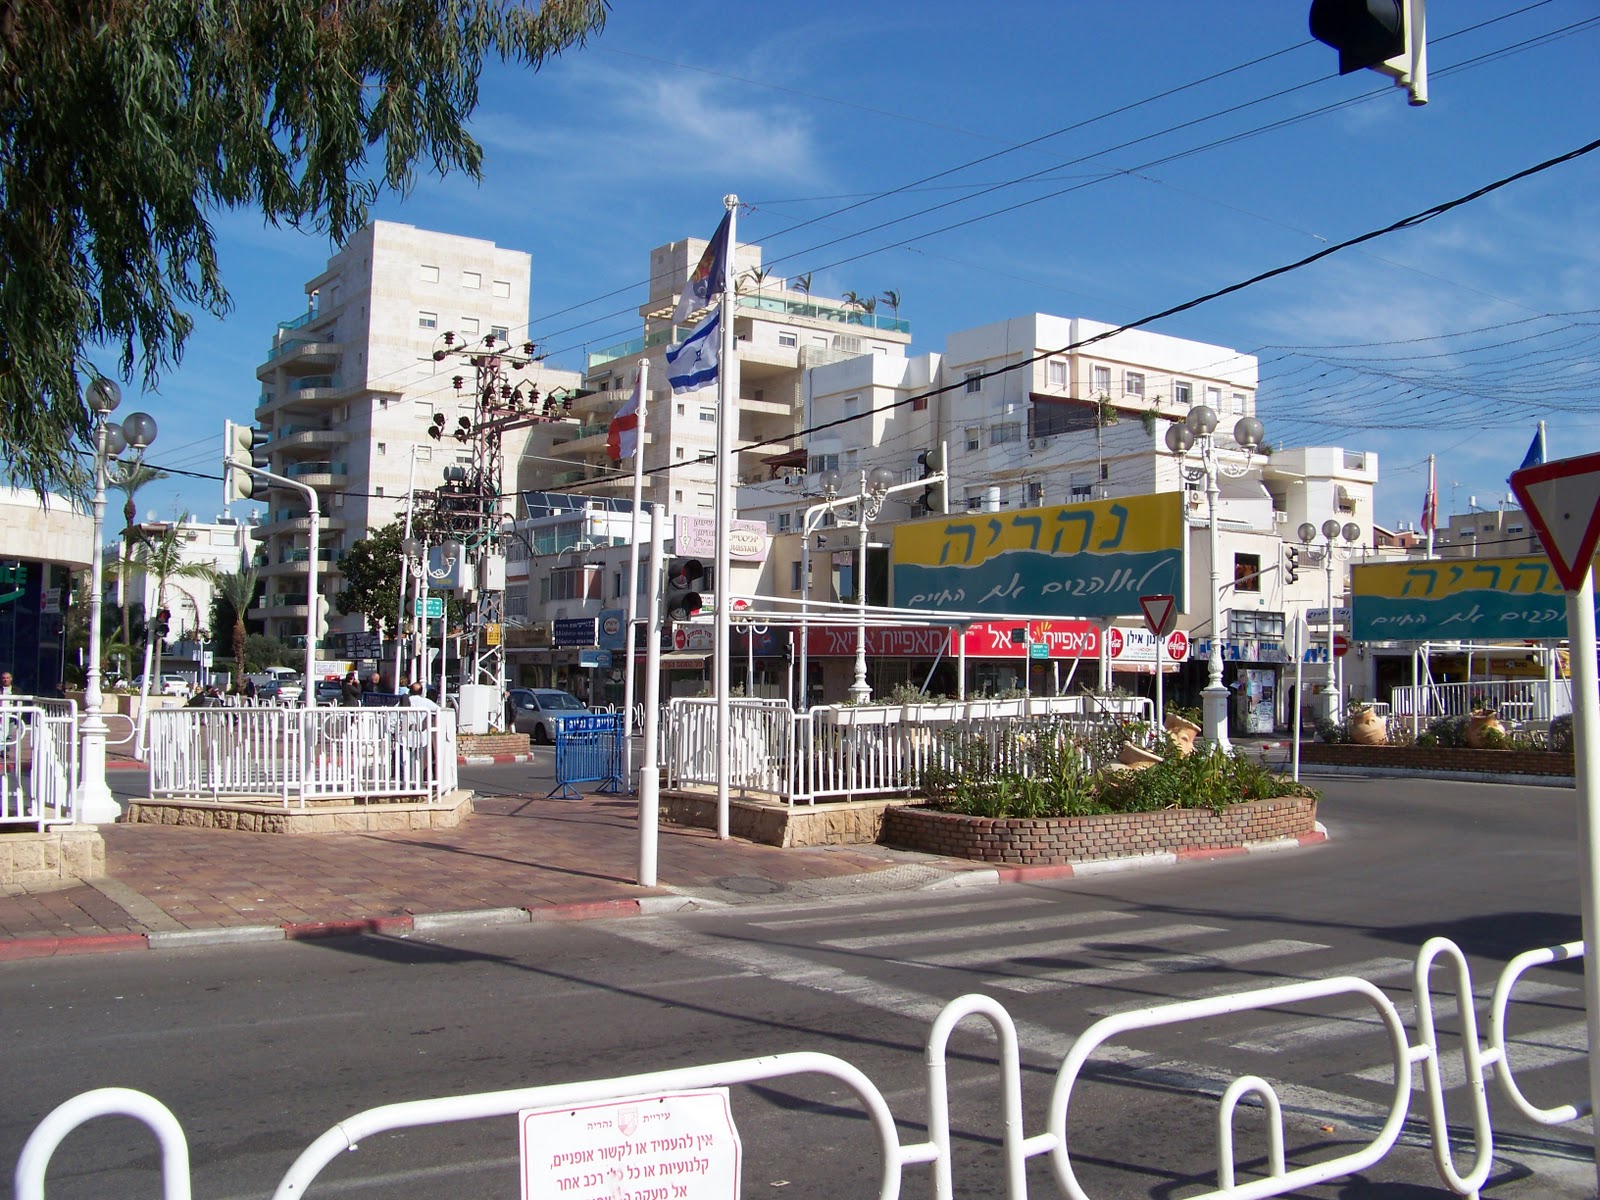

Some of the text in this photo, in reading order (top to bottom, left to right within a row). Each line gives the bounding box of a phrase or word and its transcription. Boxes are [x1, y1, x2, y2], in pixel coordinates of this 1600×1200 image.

[939, 503, 1129, 565] נהריה
[908, 557, 1175, 607] לאוהבים את החיים
[1401, 562, 1563, 597] הריה
[1371, 604, 1568, 627] והבים את החיים
[879, 629, 943, 654] מאפיית
[1042, 630, 1096, 650] מאפיית
[1126, 630, 1144, 647] אילן
[1146, 632, 1166, 647] מנון
[587, 1112, 671, 1130] עיריית נהריה
[597, 1141, 632, 1161] לקשור
[635, 1141, 647, 1155] או
[650, 1133, 693, 1152] להעמיד
[696, 1133, 713, 1151] אין
[626, 1164, 640, 1180] כל
[643, 1165, 656, 1178] או
[659, 1156, 709, 1176] קלנועיות
[556, 1175, 580, 1191] אחר
[583, 1172, 604, 1188] רכב
[671, 1183, 687, 1198] אל
